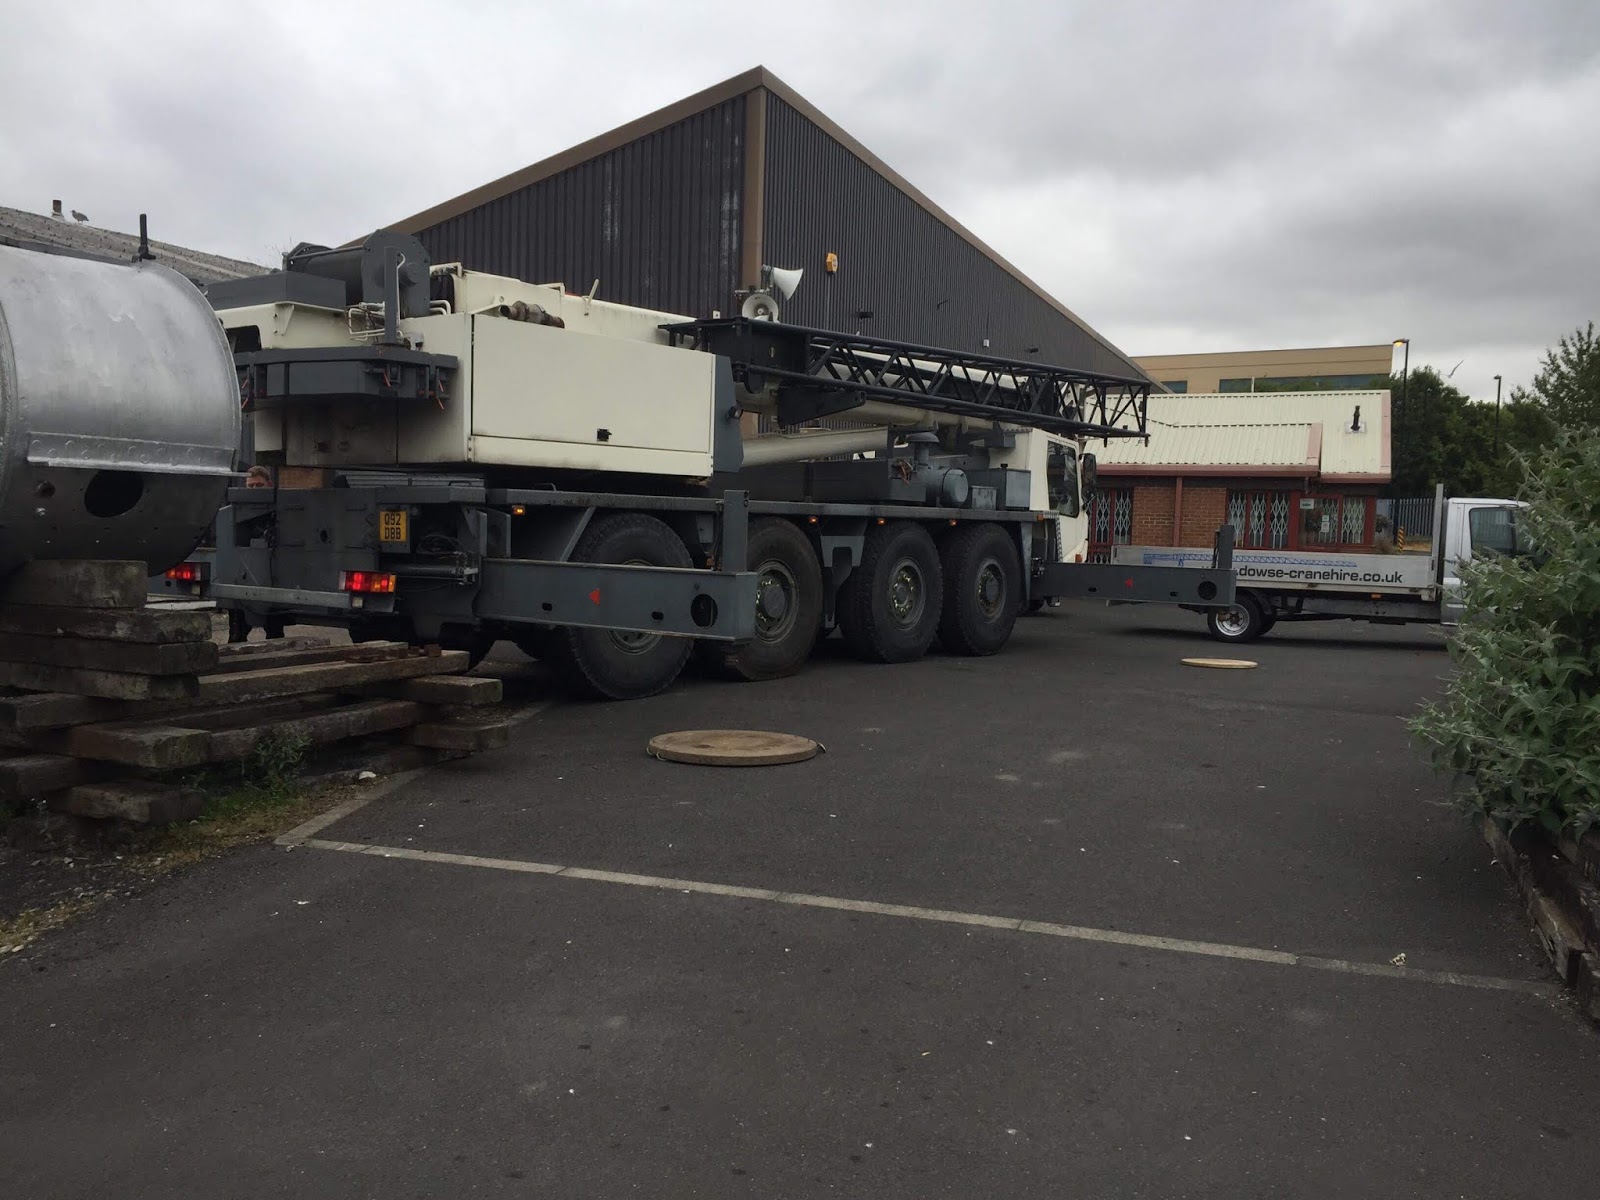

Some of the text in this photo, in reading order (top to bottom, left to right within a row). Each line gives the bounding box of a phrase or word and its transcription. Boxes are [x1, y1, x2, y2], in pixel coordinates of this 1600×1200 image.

[384, 513, 402, 526] Q92
[384, 527, 402, 540] DBB
[1201, 565, 1403, 583] .dowse-cranehire.co.uk
